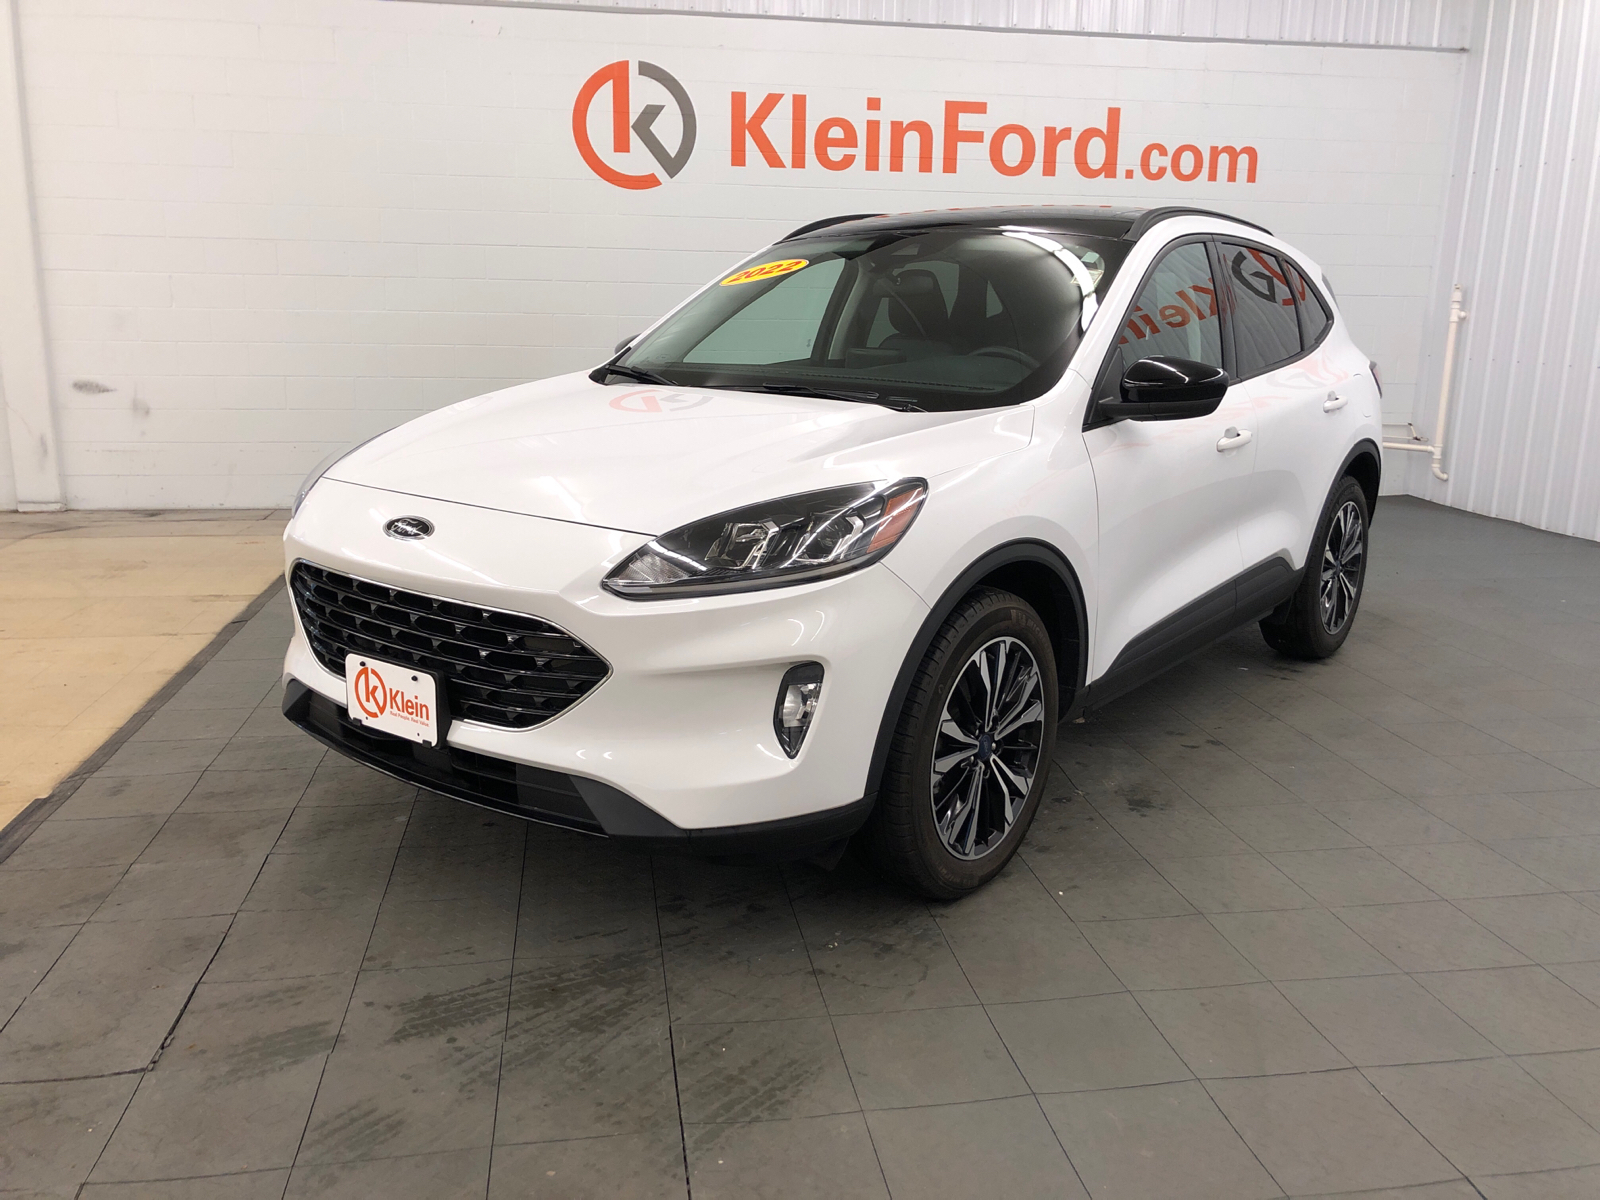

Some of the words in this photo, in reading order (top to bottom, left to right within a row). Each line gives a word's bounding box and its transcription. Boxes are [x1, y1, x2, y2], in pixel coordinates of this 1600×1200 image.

[730, 91, 1258, 184] KleinFord.com
[727, 260, 802, 283] 2022
[388, 687, 430, 721] Klein
